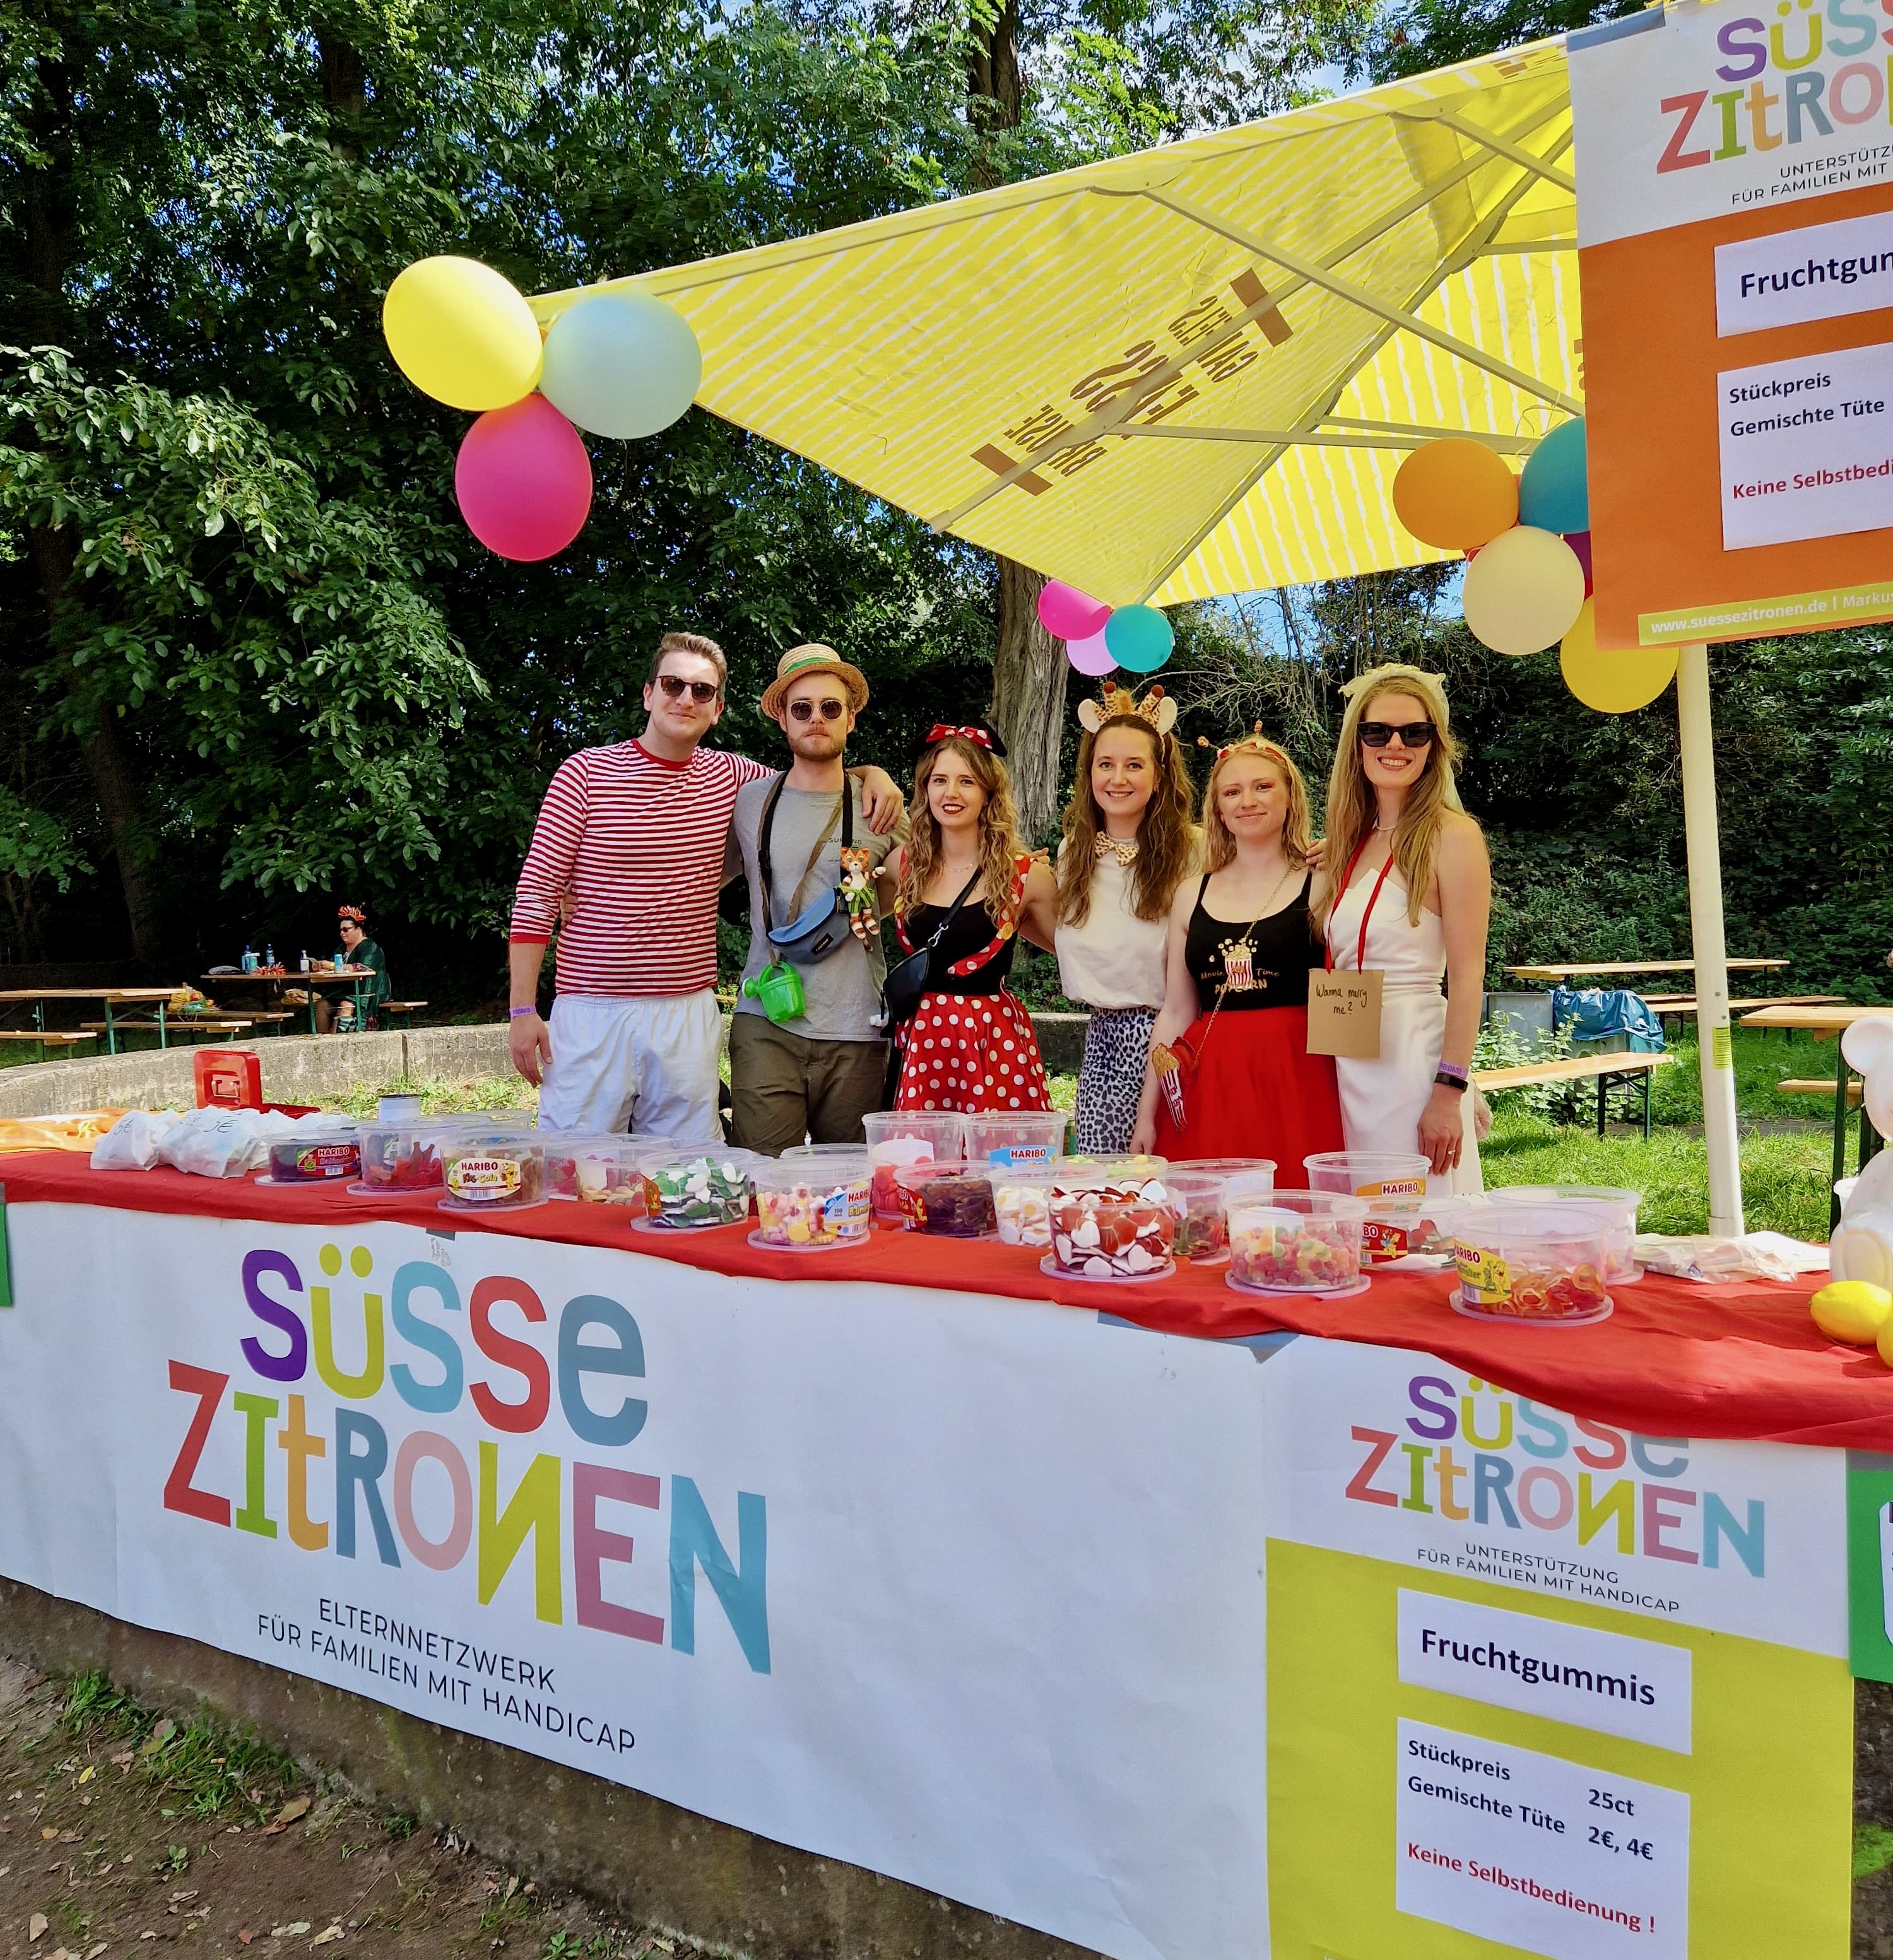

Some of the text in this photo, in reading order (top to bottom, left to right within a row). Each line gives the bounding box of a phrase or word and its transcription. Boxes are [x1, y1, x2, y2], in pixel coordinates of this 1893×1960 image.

[1656, 54, 1893, 174] ZItRO
[1780, 144, 1893, 179] UNTERSTÜTZ
[1731, 162, 1887, 205] FÜR FAMILIEN MIT
[1730, 372, 1831, 404] Stückpreis
[1730, 399, 1885, 437] Gemischte Tüte
[1733, 477, 1787, 500] Keine
[1651, 600, 1827, 635] www.suessezitronen.de
[1201, 970, 1225, 980] Movie
[1255, 968, 1280, 977] Time
[1316, 984, 1343, 997] Wanna
[318, 1146, 350, 1157] HARIBO
[461, 1162, 498, 1171] HARIBO
[1010, 1148, 1047, 1159] HARIBO
[1383, 1181, 1418, 1195] HARIBO
[1417, 1547, 1680, 1614] FÜR FAMILIEN MIT HANDICAP
[1465, 1542, 1620, 1584] UNTERSTÜTZUNG
[319, 1599, 557, 1694] ELTERNNETZWERK
[257, 1614, 636, 1755] FÜR FAMILIEN MIT HANDICAP
[1422, 1629, 1655, 1705] Fruchtgummis
[1408, 1740, 1634, 1816] Stückpreis 25ct
[1408, 1776, 1654, 1860] Gemischte Tüte 2€, 4€
[1408, 1842, 1462, 1872] Keine
[1469, 1860, 1641, 1934] Selbstbedienung
